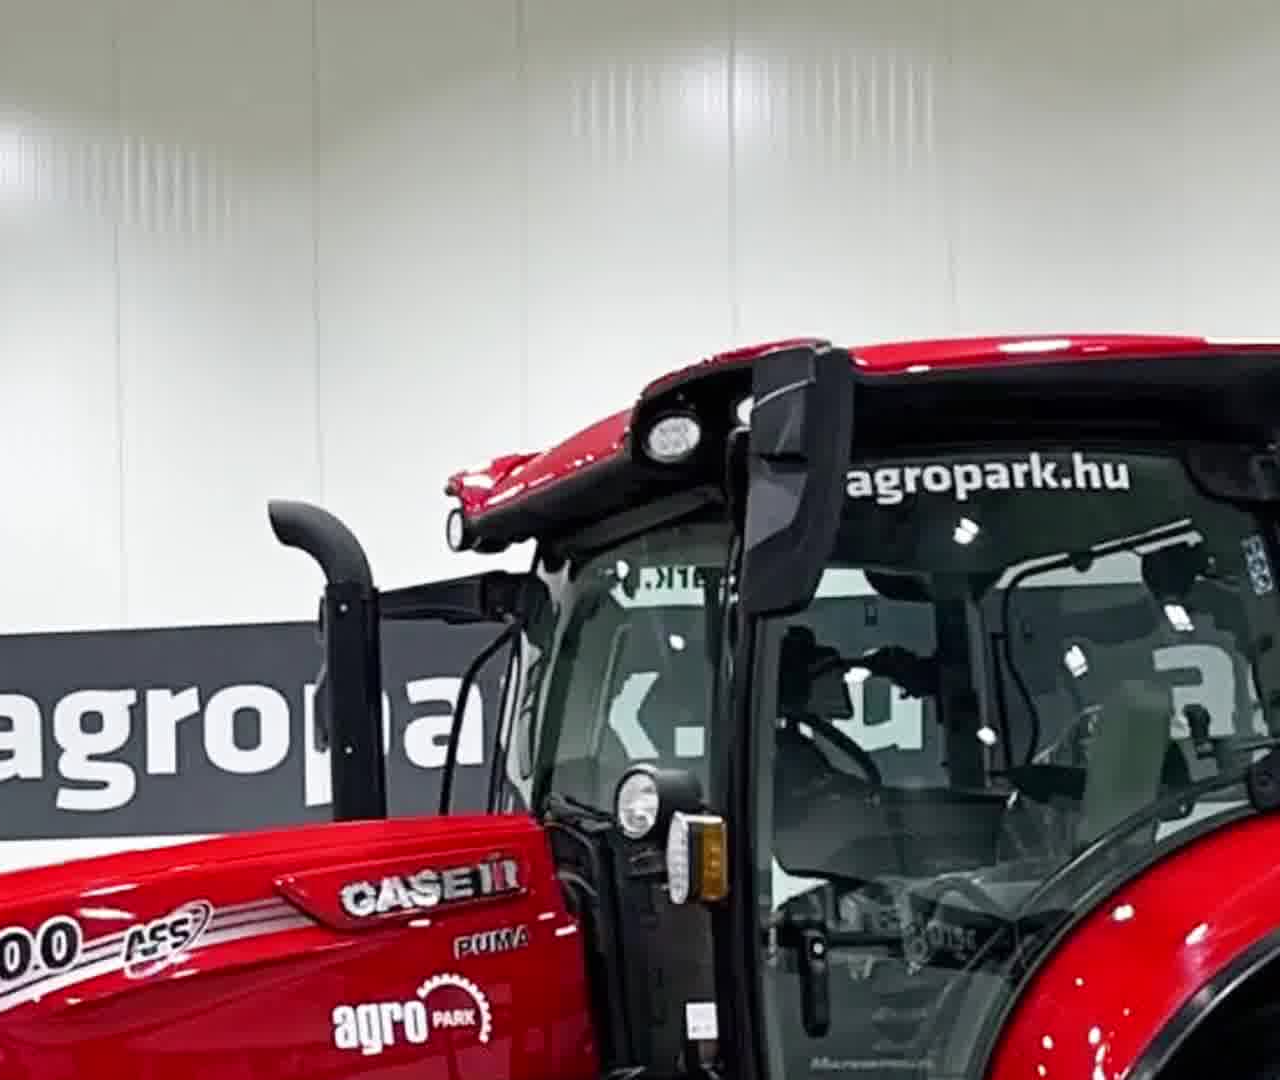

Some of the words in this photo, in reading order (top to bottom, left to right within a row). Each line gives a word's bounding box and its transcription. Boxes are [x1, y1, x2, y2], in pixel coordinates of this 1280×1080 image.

[846, 452, 1129, 504] agropark.hu
[341, 867, 474, 916] CASE
[454, 925, 528, 959] PUMA
[332, 1000, 429, 1056] agro
[432, 1010, 476, 1028] PARK
